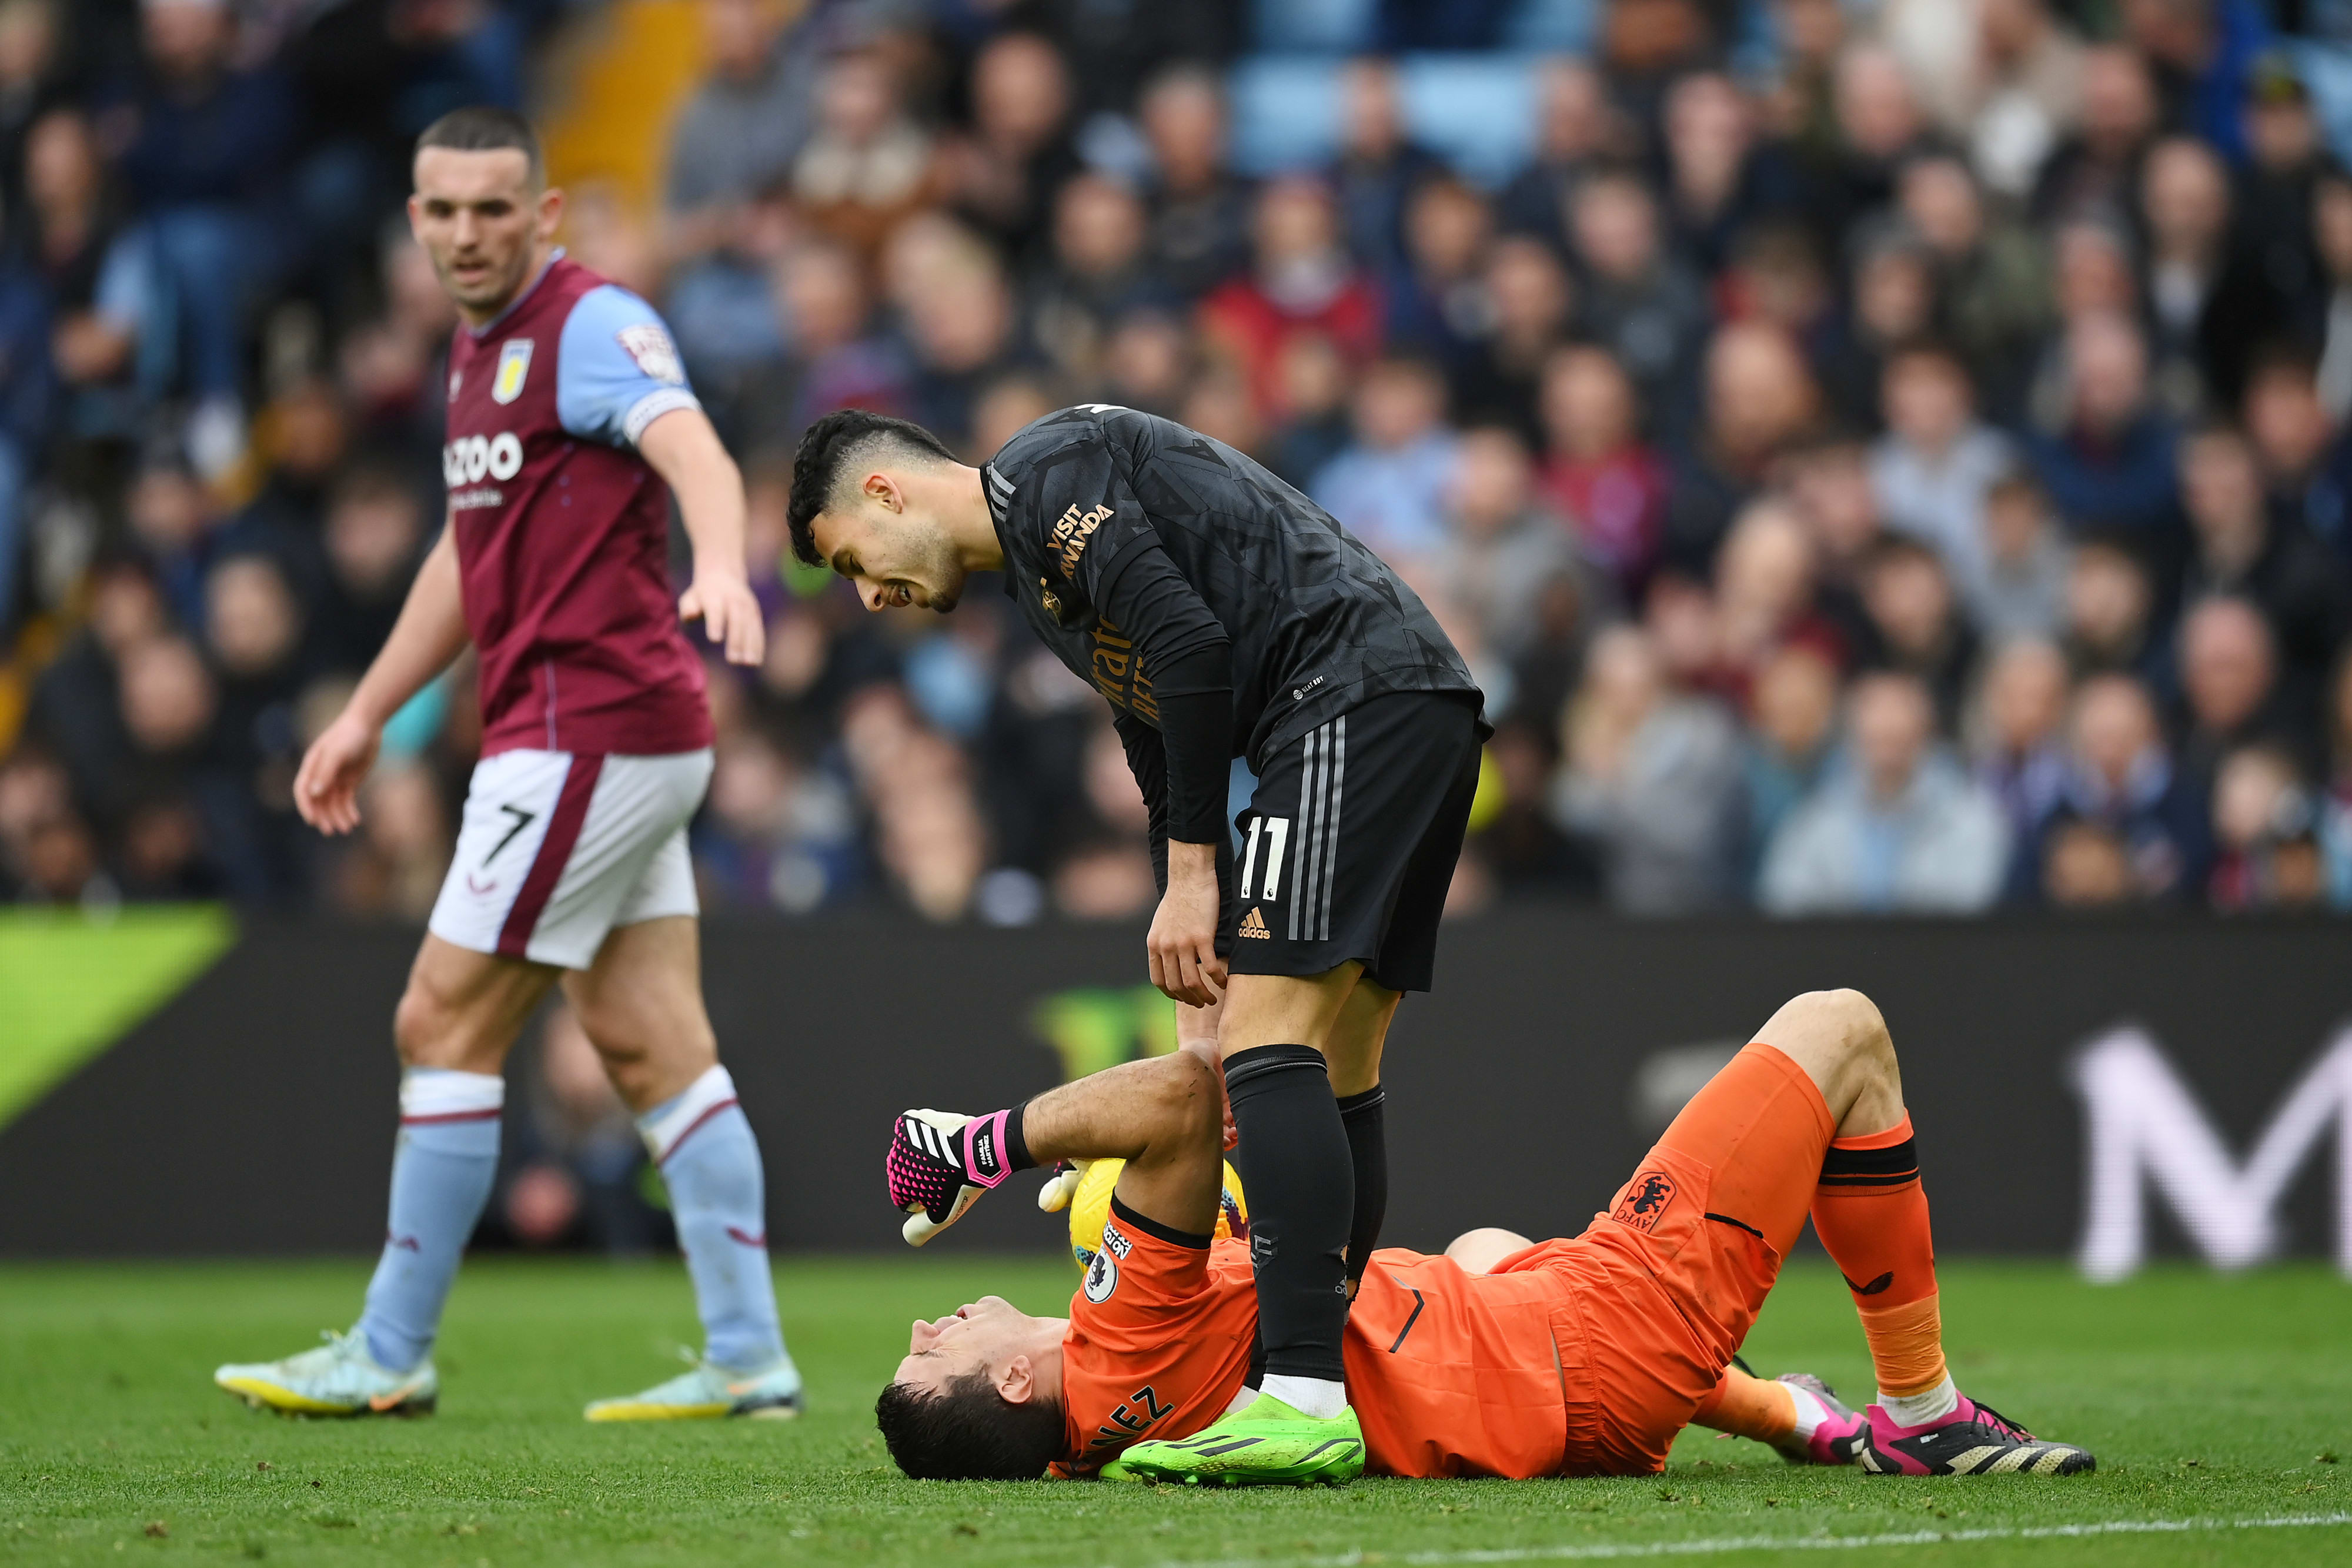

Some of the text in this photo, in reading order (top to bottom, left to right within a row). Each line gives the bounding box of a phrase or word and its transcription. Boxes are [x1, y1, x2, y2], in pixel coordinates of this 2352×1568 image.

[443, 432, 523, 487] ZOO
[1047, 503, 1083, 550] VISIT
[480, 804, 536, 869] 7
[1241, 816, 1289, 901] 11
[1238, 926, 1271, 940] adidas
[1617, 1209, 1652, 1229] AVFC
